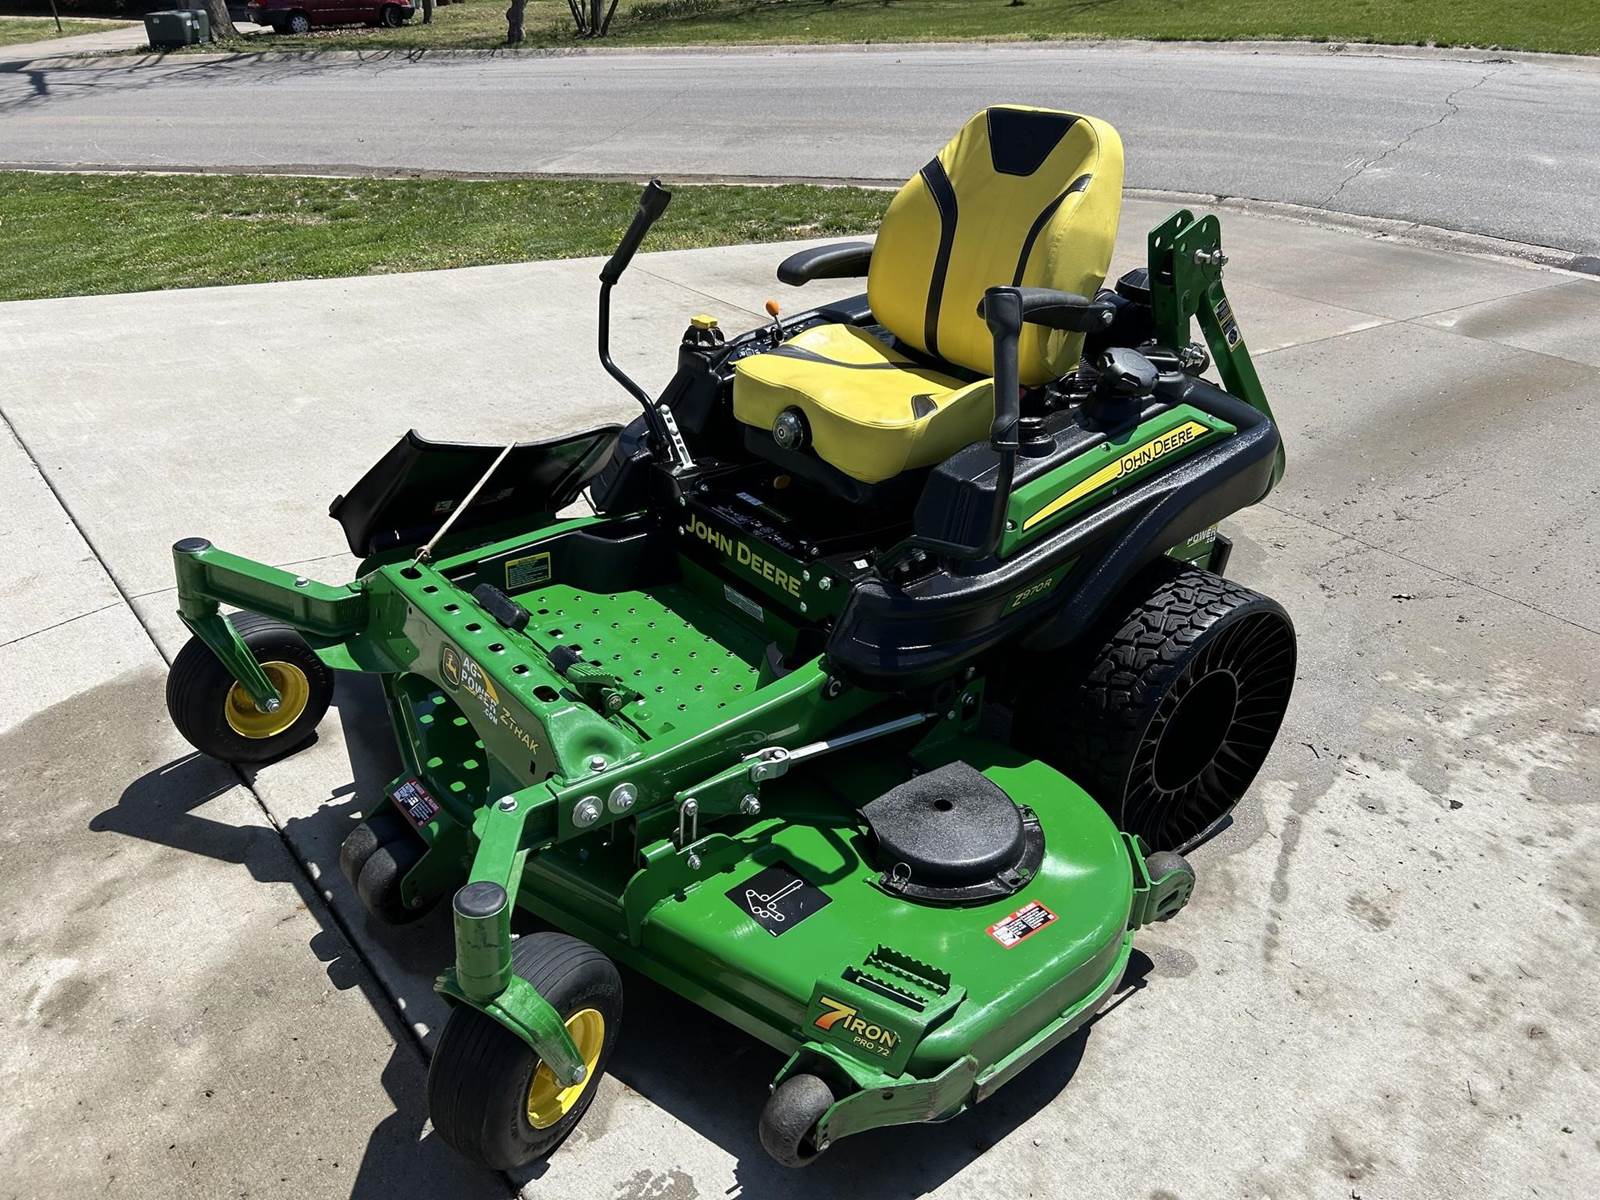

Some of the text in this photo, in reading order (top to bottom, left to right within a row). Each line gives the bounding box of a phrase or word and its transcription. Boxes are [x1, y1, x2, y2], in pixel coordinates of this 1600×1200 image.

[1116, 426, 1194, 478] JOHN DEERE
[685, 513, 801, 598] JOHN DEERE
[461, 671, 497, 715] POWER
[852, 1035, 891, 1057] PRO 72
